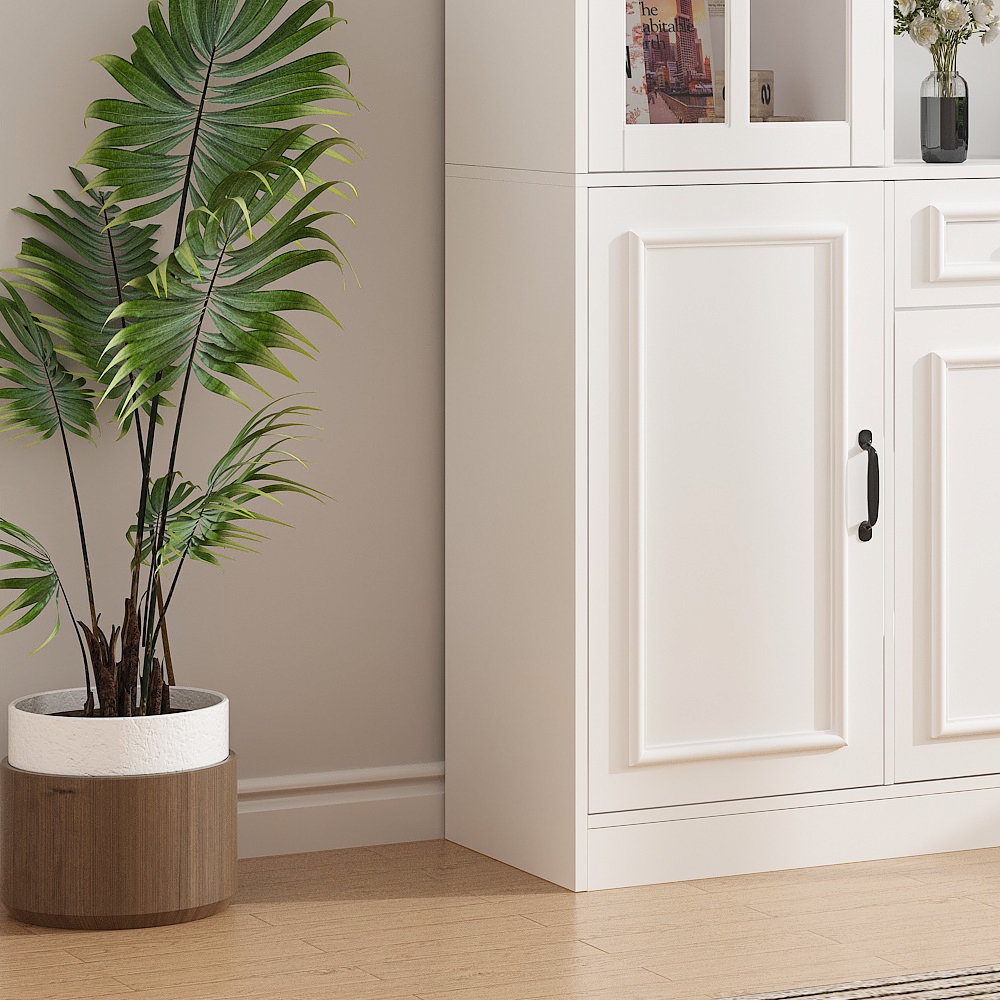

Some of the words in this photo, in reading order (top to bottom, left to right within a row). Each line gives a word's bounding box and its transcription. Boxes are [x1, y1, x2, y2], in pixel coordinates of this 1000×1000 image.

[639, 1, 658, 16] he
[642, 18, 695, 32] abitable
[643, 34, 666, 49] rth
